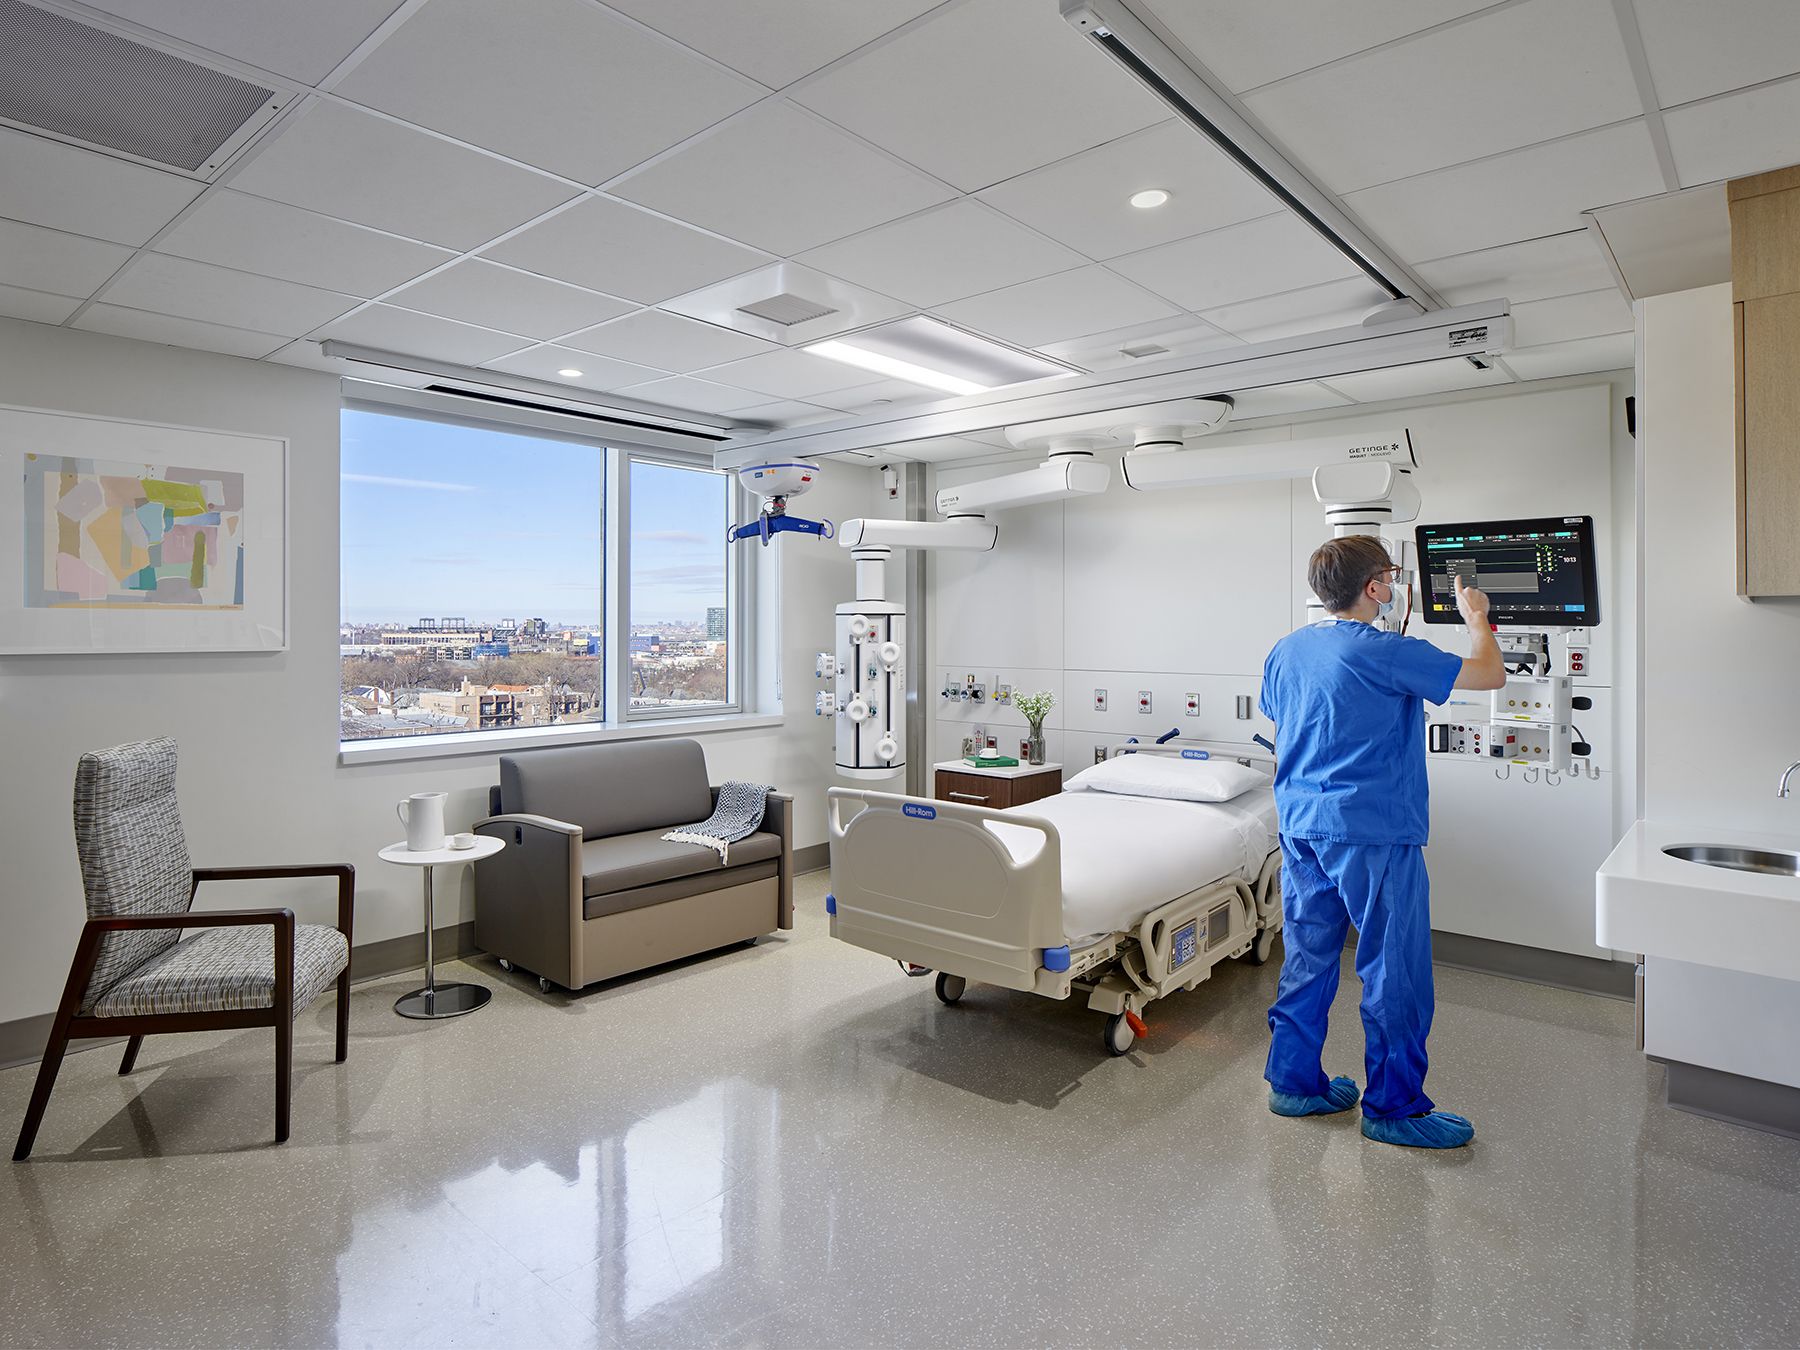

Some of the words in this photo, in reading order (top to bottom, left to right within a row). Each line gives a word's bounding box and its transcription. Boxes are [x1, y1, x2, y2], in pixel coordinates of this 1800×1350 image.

[1348, 444, 1388, 454] GETINGE
[1184, 751, 1207, 759] Hill-Rom
[905, 806, 933, 818] Hill-Rom
